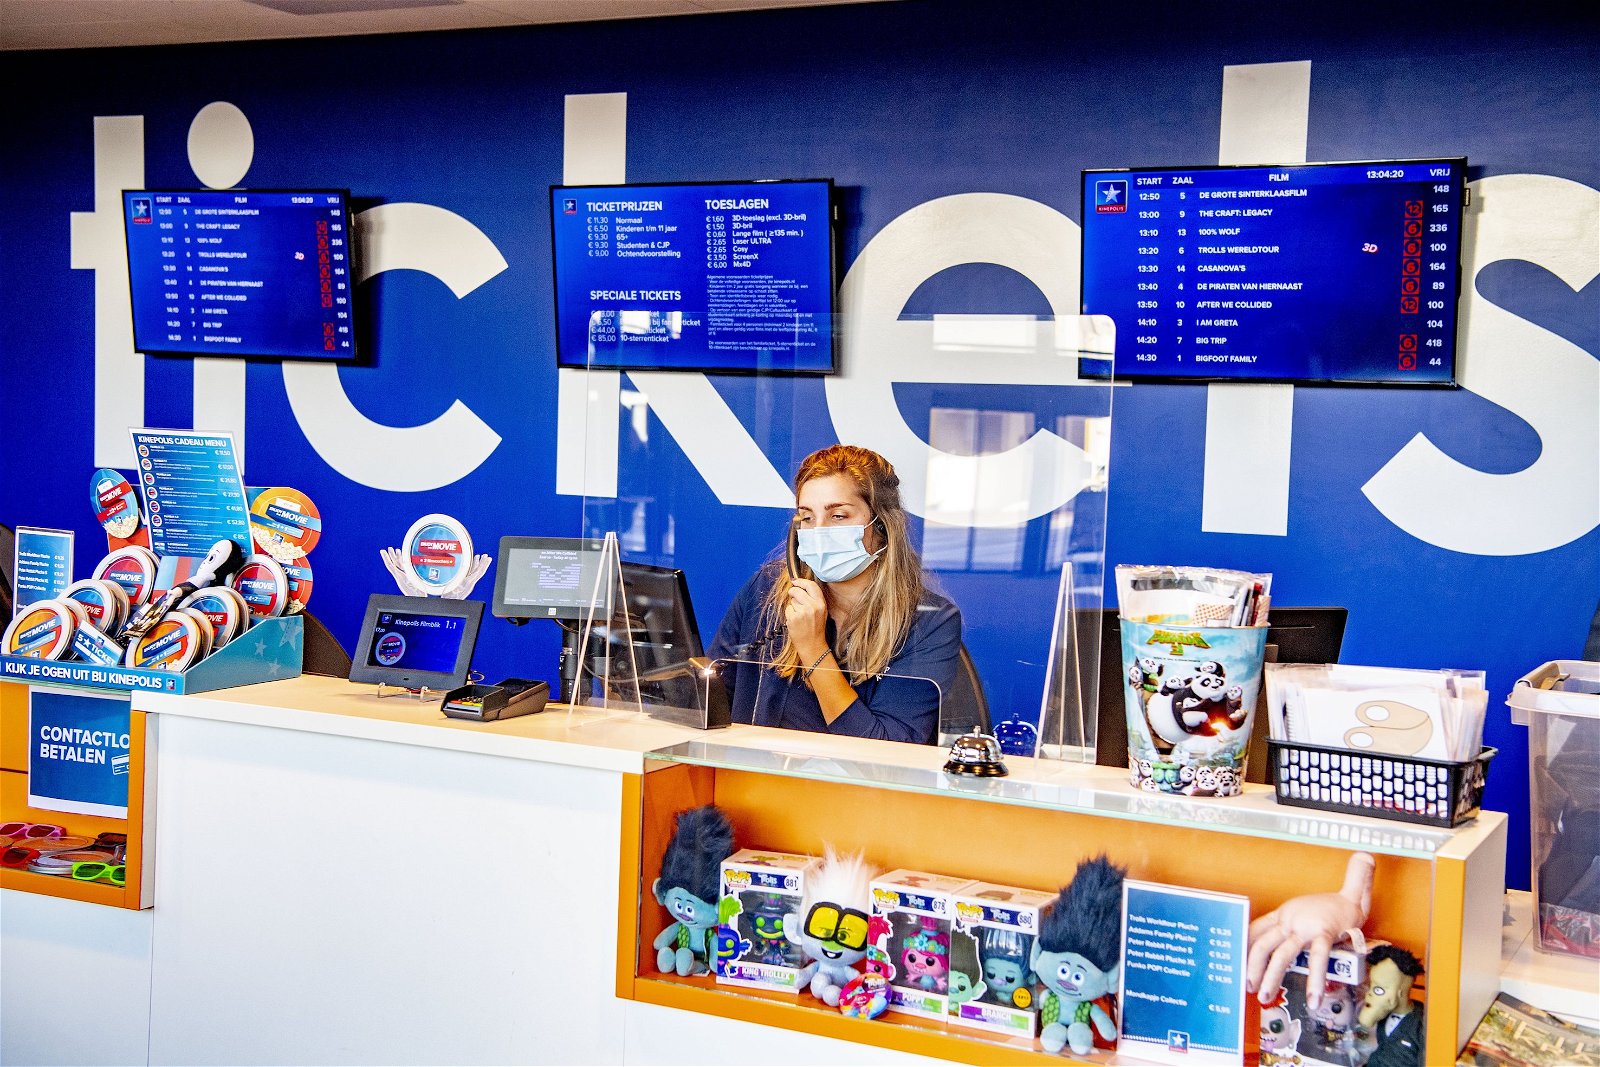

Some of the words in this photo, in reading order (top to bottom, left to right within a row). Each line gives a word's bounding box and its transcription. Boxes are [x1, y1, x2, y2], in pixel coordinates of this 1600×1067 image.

[1367, 170, 1404, 178] 13:04:20
[1238, 189, 1307, 198] SINTERKLAASFILM
[587, 201, 662, 211] TICKETPRIJZEN
[705, 199, 768, 209] TOESLAGEN
[1432, 204, 1448, 212] 165
[766, 214, 782, 222] (excl.
[665, 225, 677, 233] jaar
[1430, 224, 1447, 232] 336
[1362, 243, 1377, 252] 3D
[1430, 243, 1446, 251] 100
[617, 250, 681, 258] Ochtendvoorstelling
[591, 290, 637, 300] SPECIALE
[639, 291, 681, 300] TICKETS
[138, 436, 173, 445] KINEPOLIS
[174, 438, 204, 446] CADEAU
[205, 439, 226, 447] MENU
[281, 511, 308, 525] MOVIE
[433, 541, 457, 551] MOVIE
[120, 573, 142, 582] MOVIE
[252, 581, 274, 591] MOVIE
[31, 619, 56, 635] MOVIE
[156, 629, 181, 648] MOVIE
[5, 662, 27, 674] KIJK
[28, 665, 42, 676] JE
[43, 667, 71, 679] OGEN
[73, 669, 90, 680] UIT
[92, 672, 107, 683] BIJ
[109, 672, 162, 688] KINEPOLIS
[40, 743, 106, 765] BETALEN
[785, 878, 797, 888] 881
[933, 900, 945, 910] 878
[1019, 914, 1031, 924] 880
